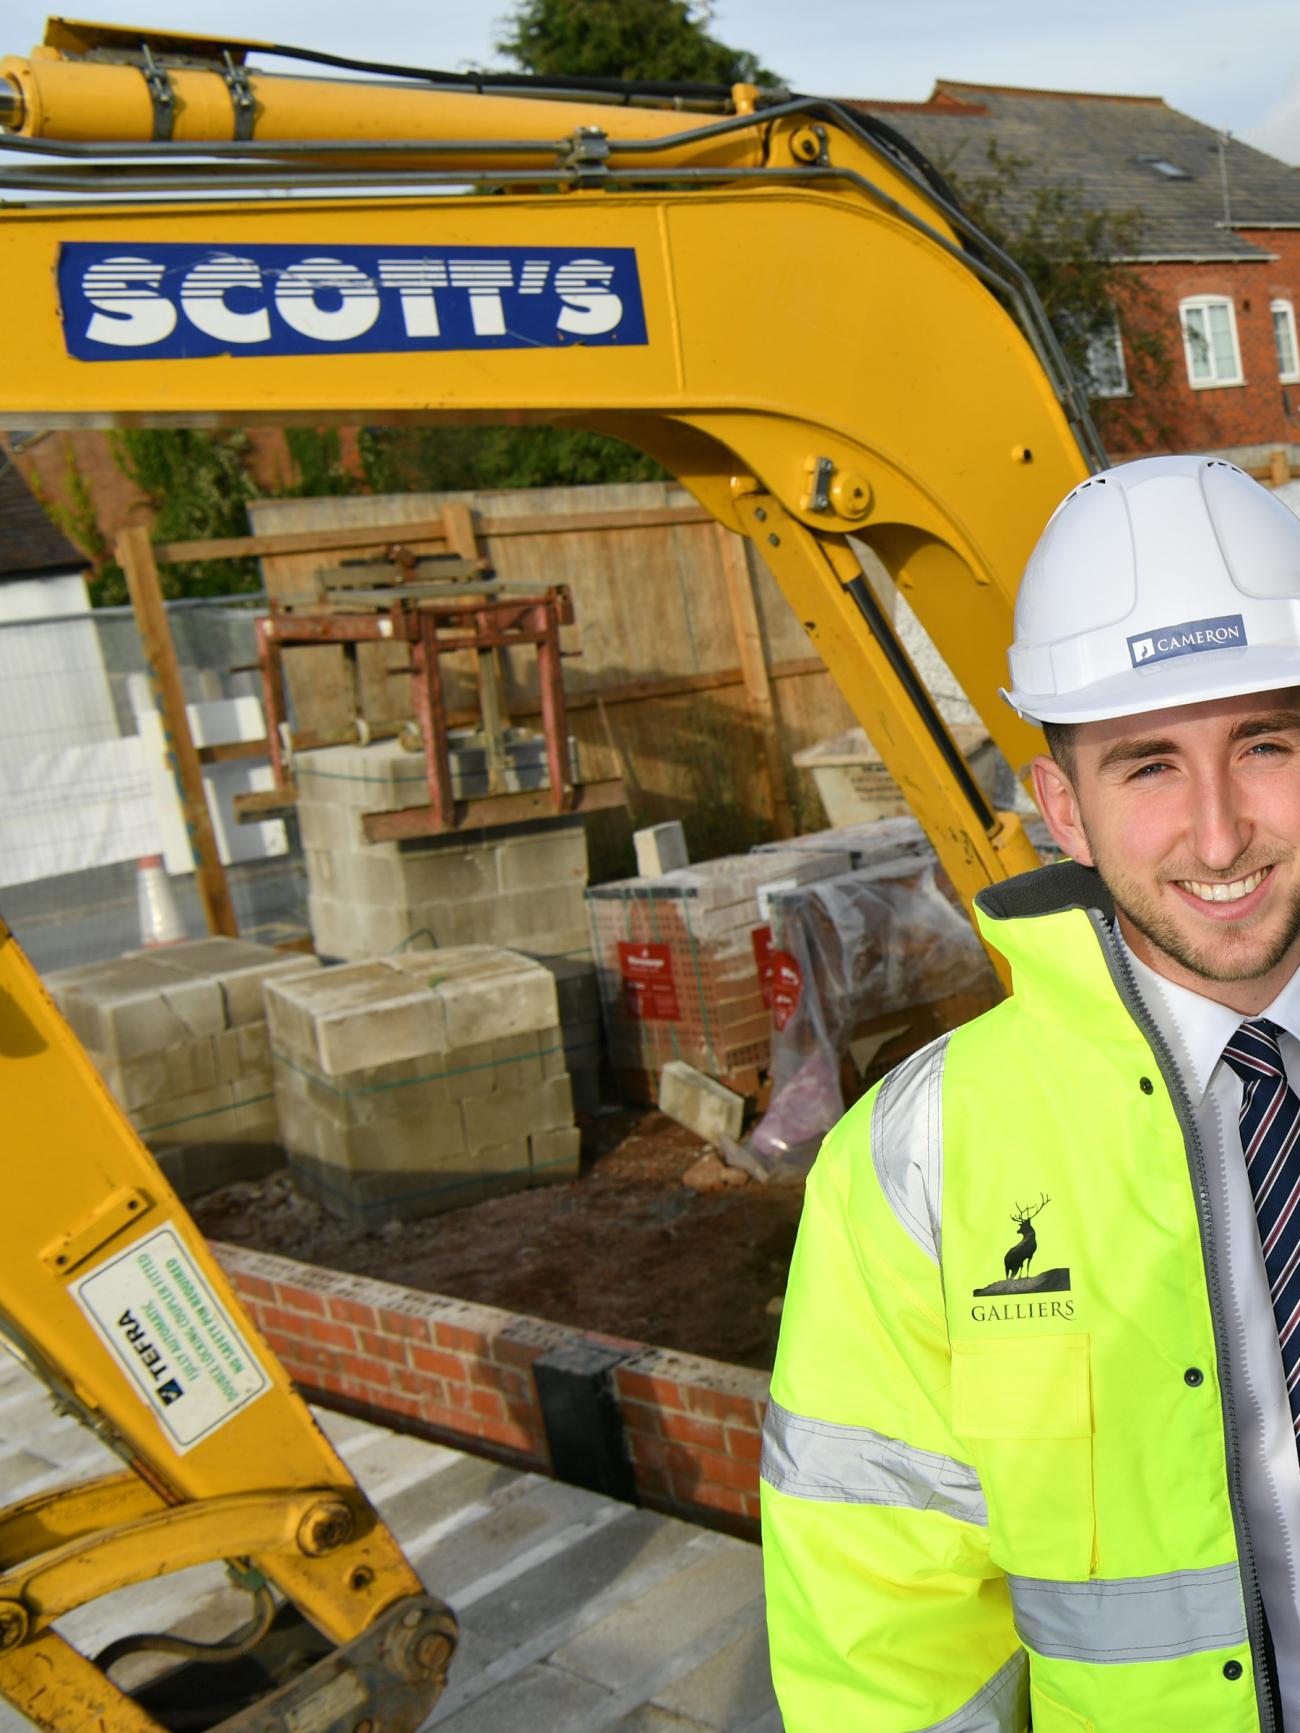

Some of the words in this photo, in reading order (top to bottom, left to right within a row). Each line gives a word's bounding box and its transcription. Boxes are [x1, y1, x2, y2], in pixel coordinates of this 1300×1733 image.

[82, 256, 624, 346] SCOTT'S
[1157, 625, 1240, 652] CAMERON
[135, 1251, 164, 1288] FITTED
[164, 1257, 202, 1308] REQUIRED
[155, 1283, 191, 1329] COUPLER
[195, 1305, 213, 1326] PIN
[971, 1300, 1077, 1321] GALLIERS
[117, 1309, 168, 1381] TEFRA
[140, 1299, 182, 1355] AUTOMATIC
[206, 1322, 235, 1360] SAFETY
[182, 1325, 216, 1368] LOCKING
[174, 1350, 200, 1382] FULLY
[228, 1357, 244, 1375] NO
